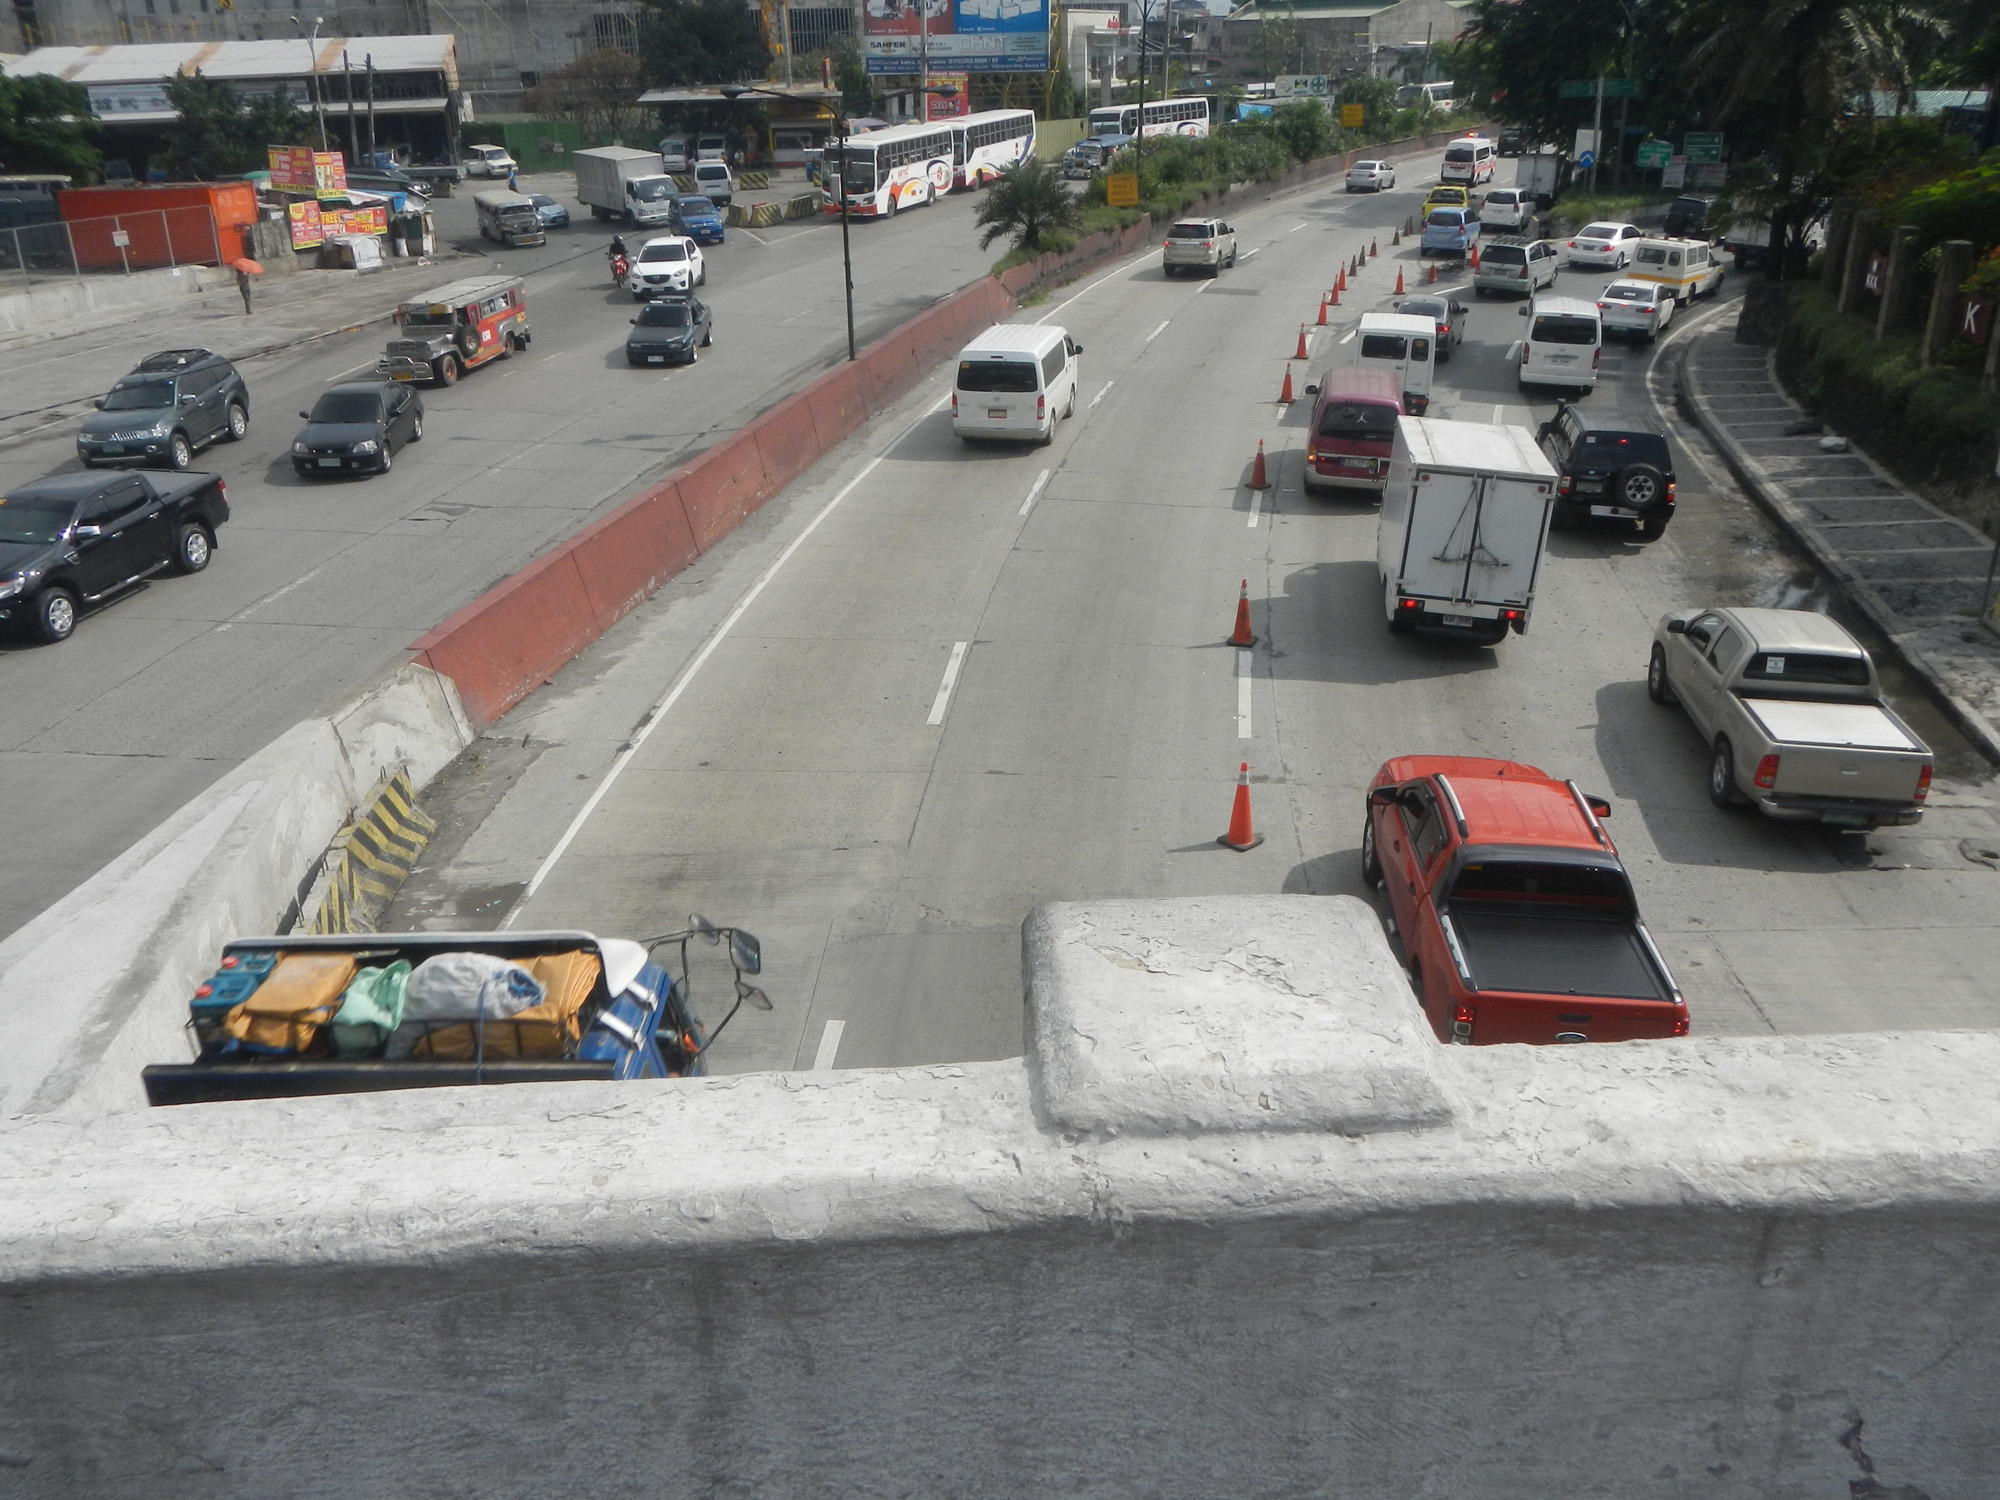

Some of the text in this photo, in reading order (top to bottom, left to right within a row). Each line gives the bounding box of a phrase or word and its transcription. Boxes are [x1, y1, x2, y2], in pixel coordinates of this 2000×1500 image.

[870, 41, 906, 49] SANFER
[321, 213, 338, 224] FREE
[1963, 301, 1981, 334] K
